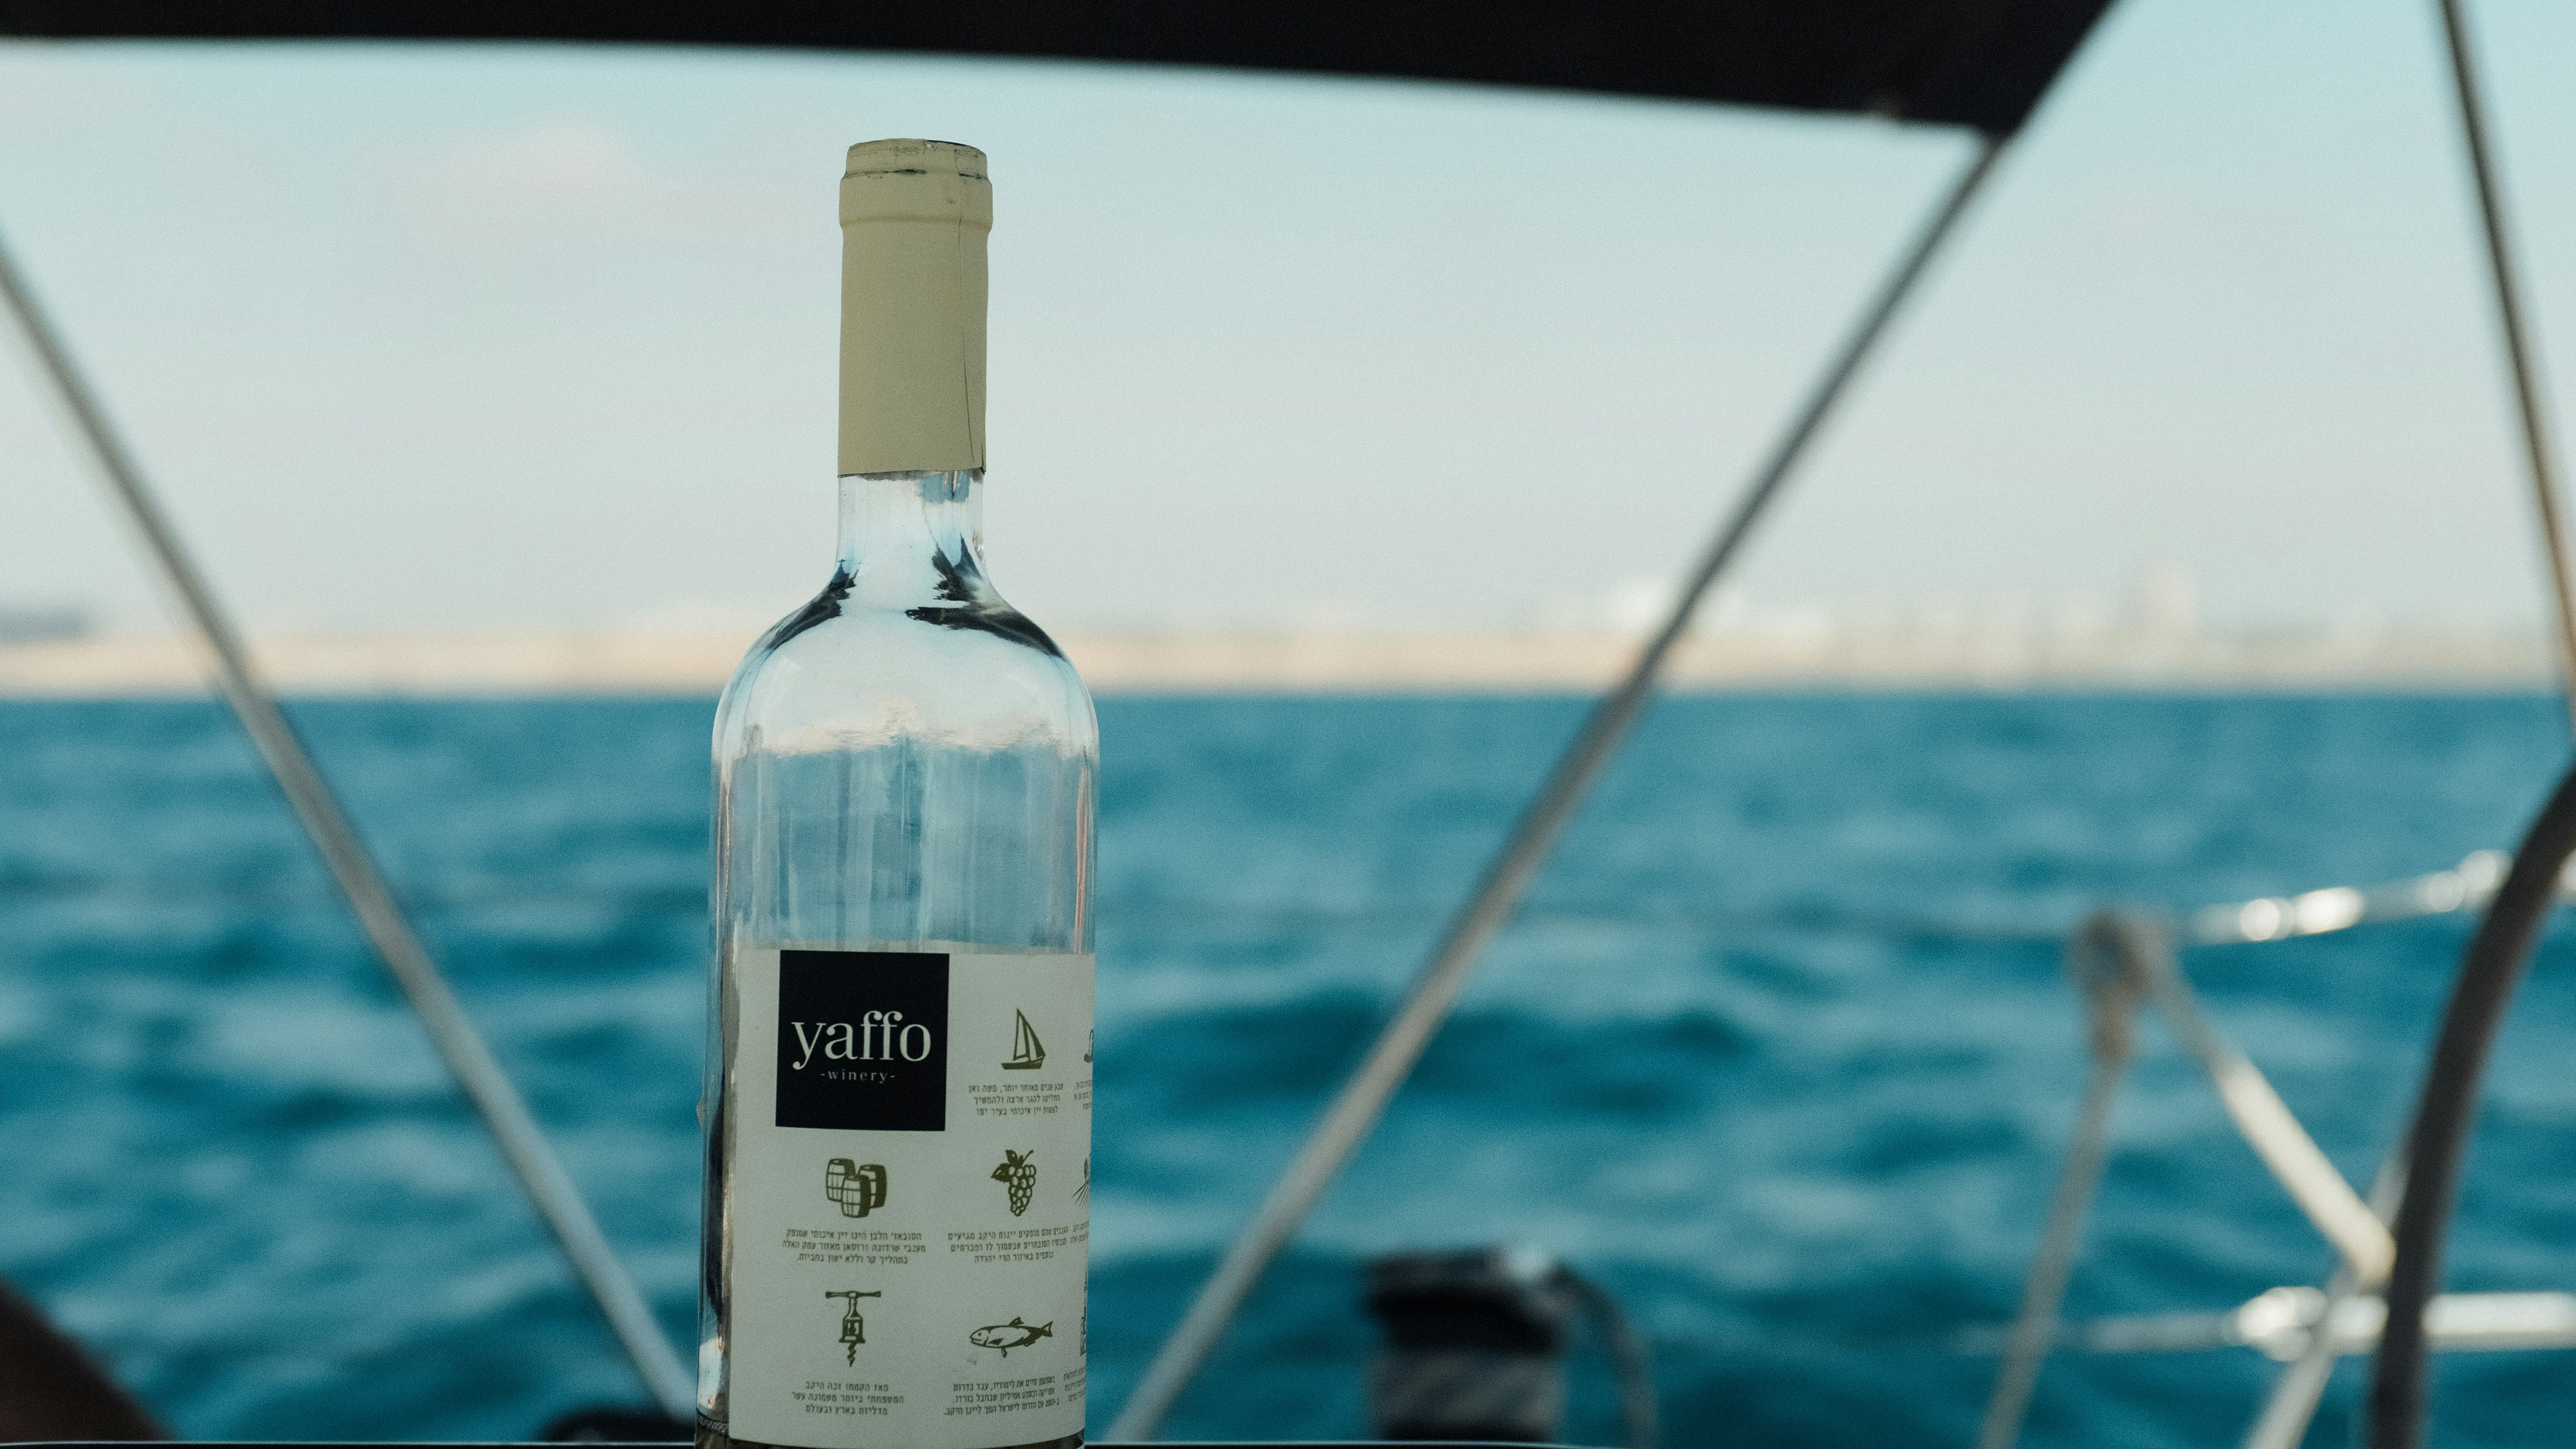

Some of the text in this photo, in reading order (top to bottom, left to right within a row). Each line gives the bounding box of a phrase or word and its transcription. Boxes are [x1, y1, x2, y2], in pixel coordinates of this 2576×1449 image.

[790, 1010, 932, 1071] yaffo
[1000, 1085, 1018, 1093] יותר,
[973, 1095, 1004, 1104] ולהמשיך
[1026, 1094, 1040, 1102] להגר
[1042, 1094, 1060, 1102] החליטו
[1043, 1105, 1058, 1114] לעשות
[786, 1229, 808, 1238] שמופק
[811, 1230, 834, 1239] איכותי
[1018, 1230, 1039, 1238] מופקים
[1053, 1226, 1068, 1235] הענבים
[837, 1232, 848, 1241] יין
[869, 1231, 888, 1241] הלבן
[978, 1232, 996, 1240] היקב
[782, 1239, 800, 1248] האלה
[802, 1242, 816, 1250] עמק
[843, 1243, 868, 1252] ורוסאן
[872, 1244, 900, 1252] שרדונה
[950, 1244, 983, 1252] ומכרמים
[985, 1242, 993, 1251] לו
[996, 1243, 1021, 1251] שבסמוך
[1023, 1240, 1050, 1249] המובחרים
[845, 1254, 863, 1262] וללא
[866, 1256, 876, 1264] קר
[879, 1254, 908, 1265] בתהליך
[1035, 1252, 1053, 1260] נוספים
[805, 1381, 824, 1389] היקב
[846, 1383, 870, 1392] הקמתו
[1025, 1379, 1037, 1387] סיים
[792, 1392, 805, 1400] עשר
[999, 1392, 1020, 1402] אמיליון
[1022, 1390, 1037, 1398] ובסנט
[1038, 1388, 1055, 1397] אפריקה
[808, 1393, 837, 1402] משמונה
[840, 1394, 863, 1403] ביותר
[975, 1393, 997, 1402] שבחבל
[806, 1404, 832, 1413] ובעולם
[859, 1406, 888, 1415] מדליות
[966, 1405, 982, 1415] ליינן
[984, 1406, 996, 1415] הפך
[998, 1402, 1020, 1412] לישראל
[1022, 1402, 1036, 1410] חזרתו
[944, 1407, 963, 1415] היקב.
